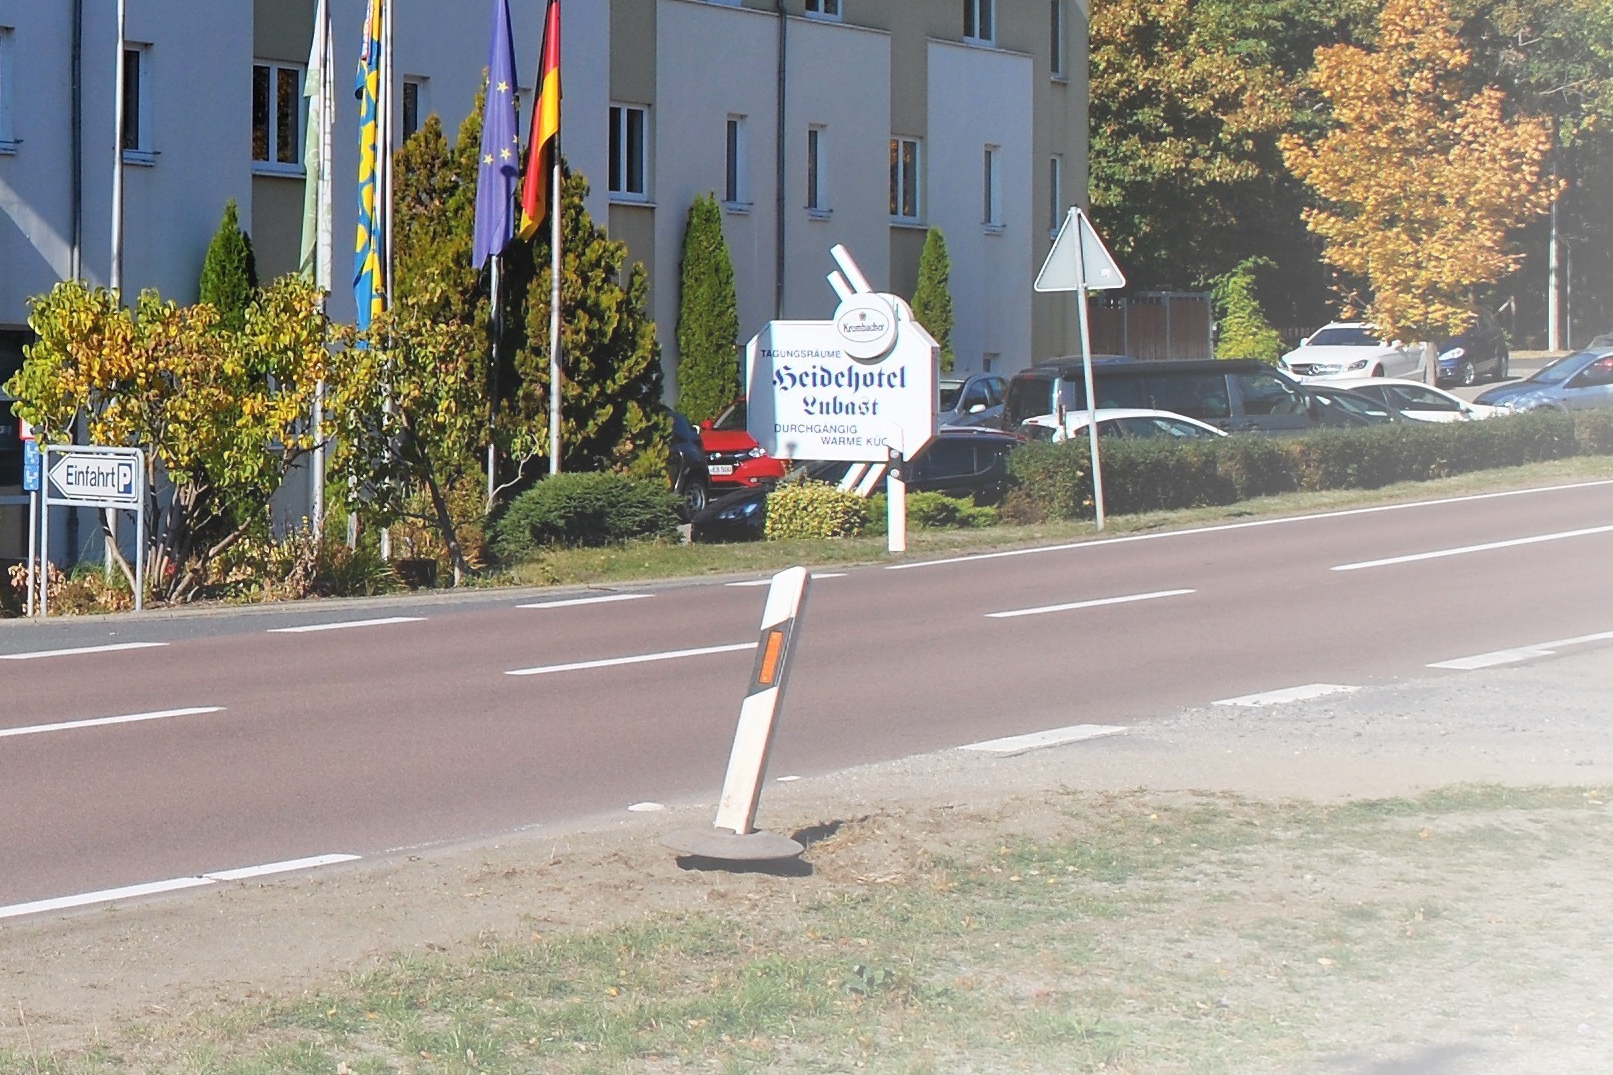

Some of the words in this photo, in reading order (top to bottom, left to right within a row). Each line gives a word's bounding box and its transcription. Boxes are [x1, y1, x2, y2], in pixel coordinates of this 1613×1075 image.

[772, 364, 906, 394] Heidehotel
[802, 395, 879, 416] Lubast
[66, 464, 116, 488] Einfahrt
